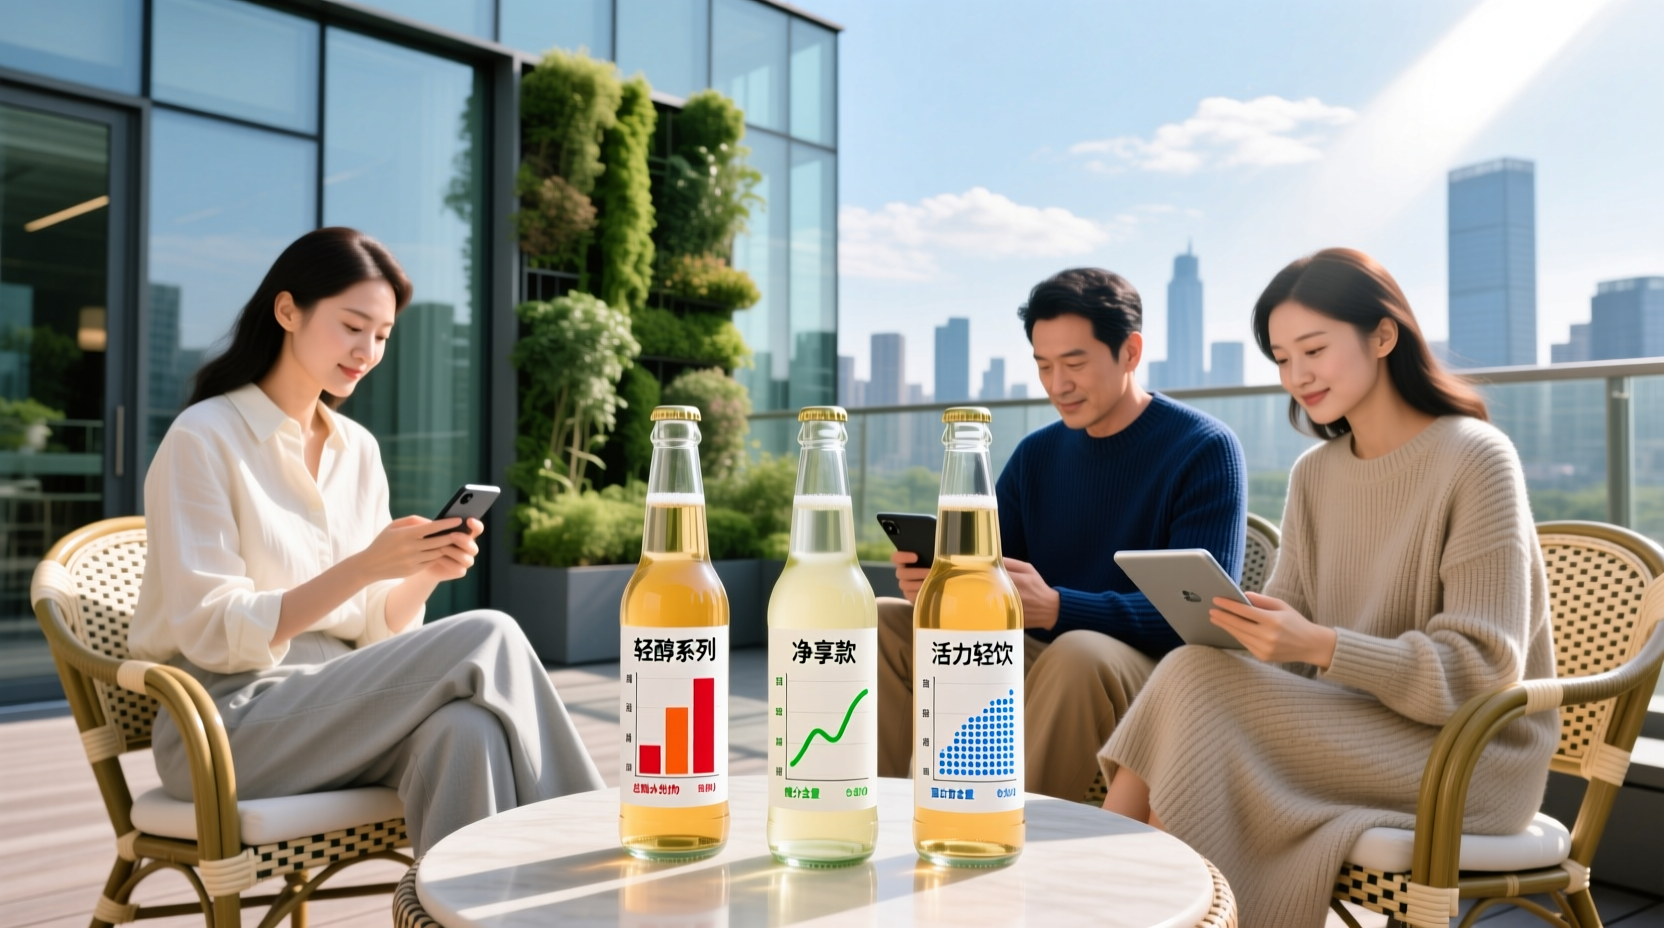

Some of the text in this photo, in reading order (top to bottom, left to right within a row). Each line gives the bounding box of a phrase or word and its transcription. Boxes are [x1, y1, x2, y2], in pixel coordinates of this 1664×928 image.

[633, 637, 716, 663] 轻醇系列
[792, 638, 856, 665] 净享款
[931, 640, 1013, 667] 活力轻饮
